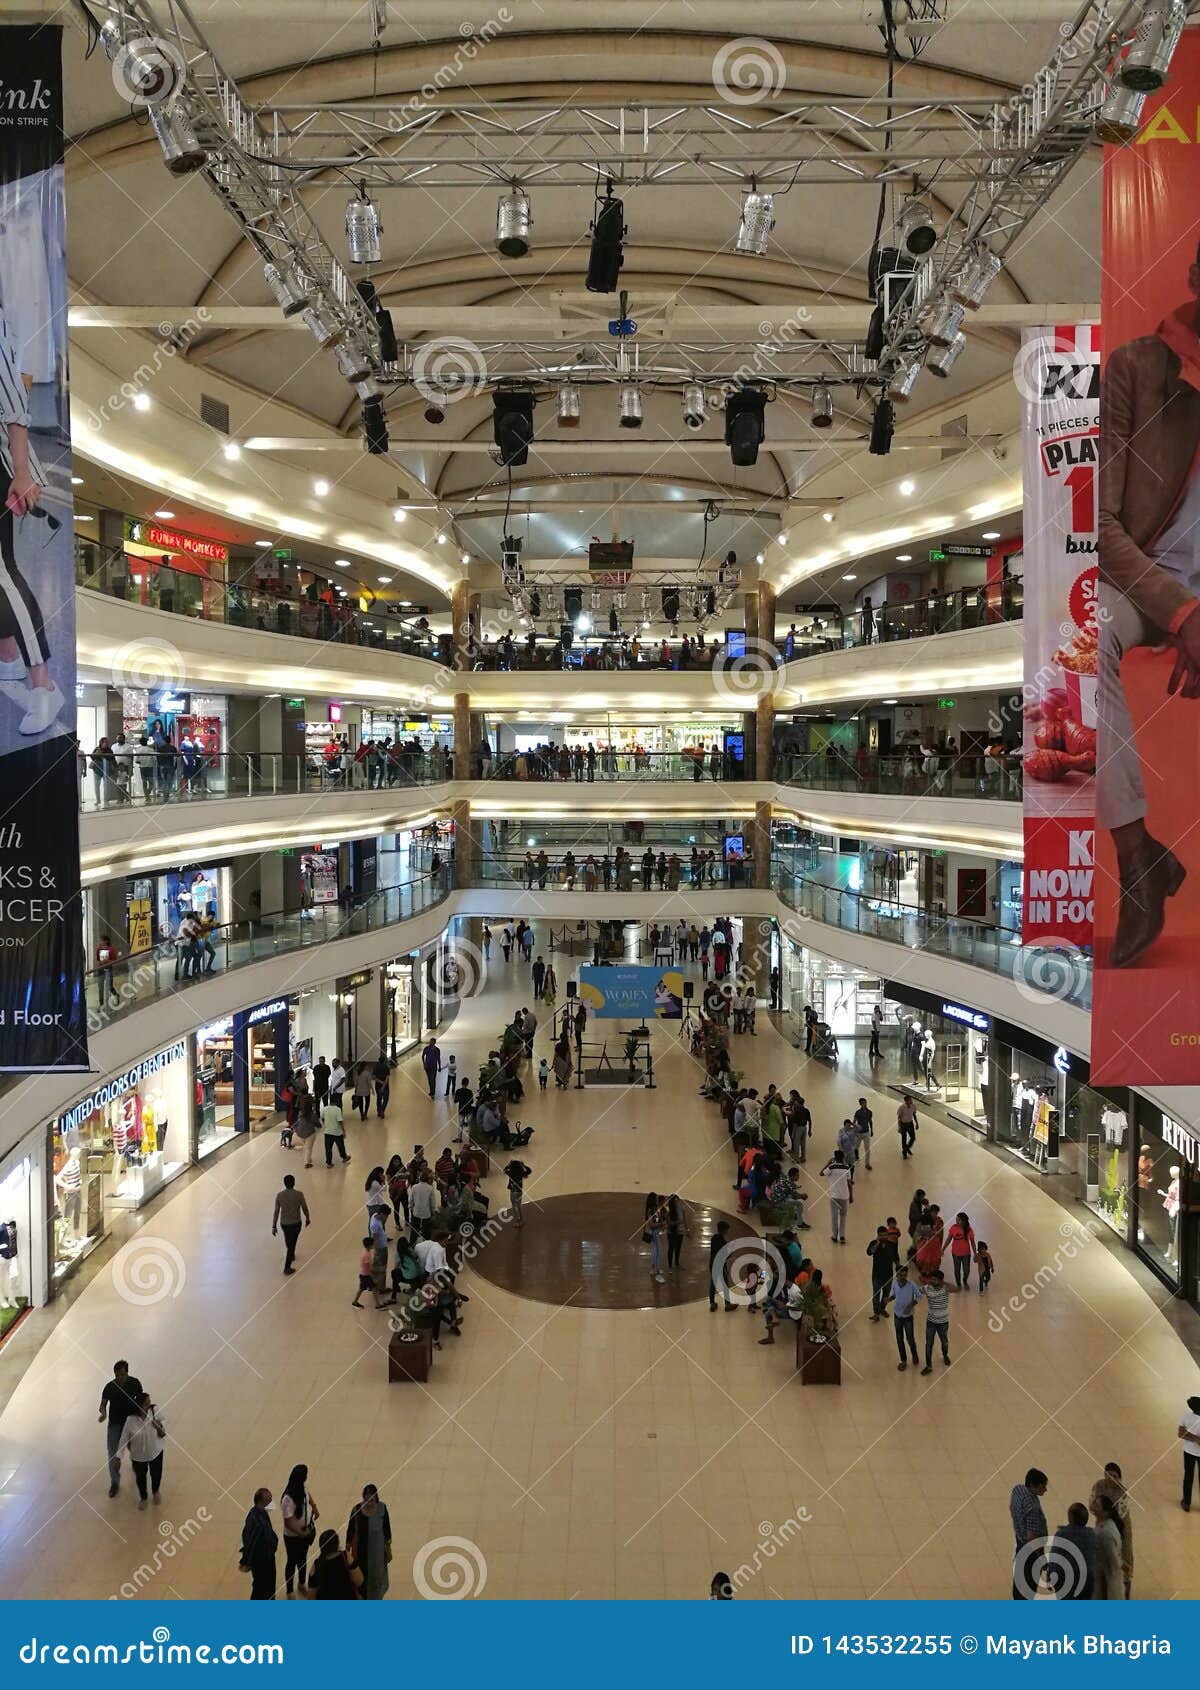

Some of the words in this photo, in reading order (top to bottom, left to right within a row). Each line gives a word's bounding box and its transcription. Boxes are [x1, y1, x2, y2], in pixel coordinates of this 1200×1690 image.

[17, 117, 49, 126] STRIPE
[1136, 105, 1200, 144] A
[1049, 417, 1089, 434] PIECES
[150, 529, 180, 549] FUNKY
[184, 539, 226, 560] MONKEYS
[39, 866, 56, 889] &
[1030, 869, 1095, 898] NOW
[0, 899, 65, 922] CER
[1029, 900, 1051, 924] IN
[604, 989, 648, 1001] WOMEN
[14, 1009, 63, 1026] Floor
[252, 1000, 287, 1021] NAUTICA
[1171, 1032, 1200, 1046] Gro
[61, 1098, 94, 1136] UNITED
[94, 1074, 129, 1110] COLORS
[129, 1066, 142, 1087] OF
[143, 1041, 185, 1080] BENETTON
[1162, 1113, 1195, 1164] RITU
